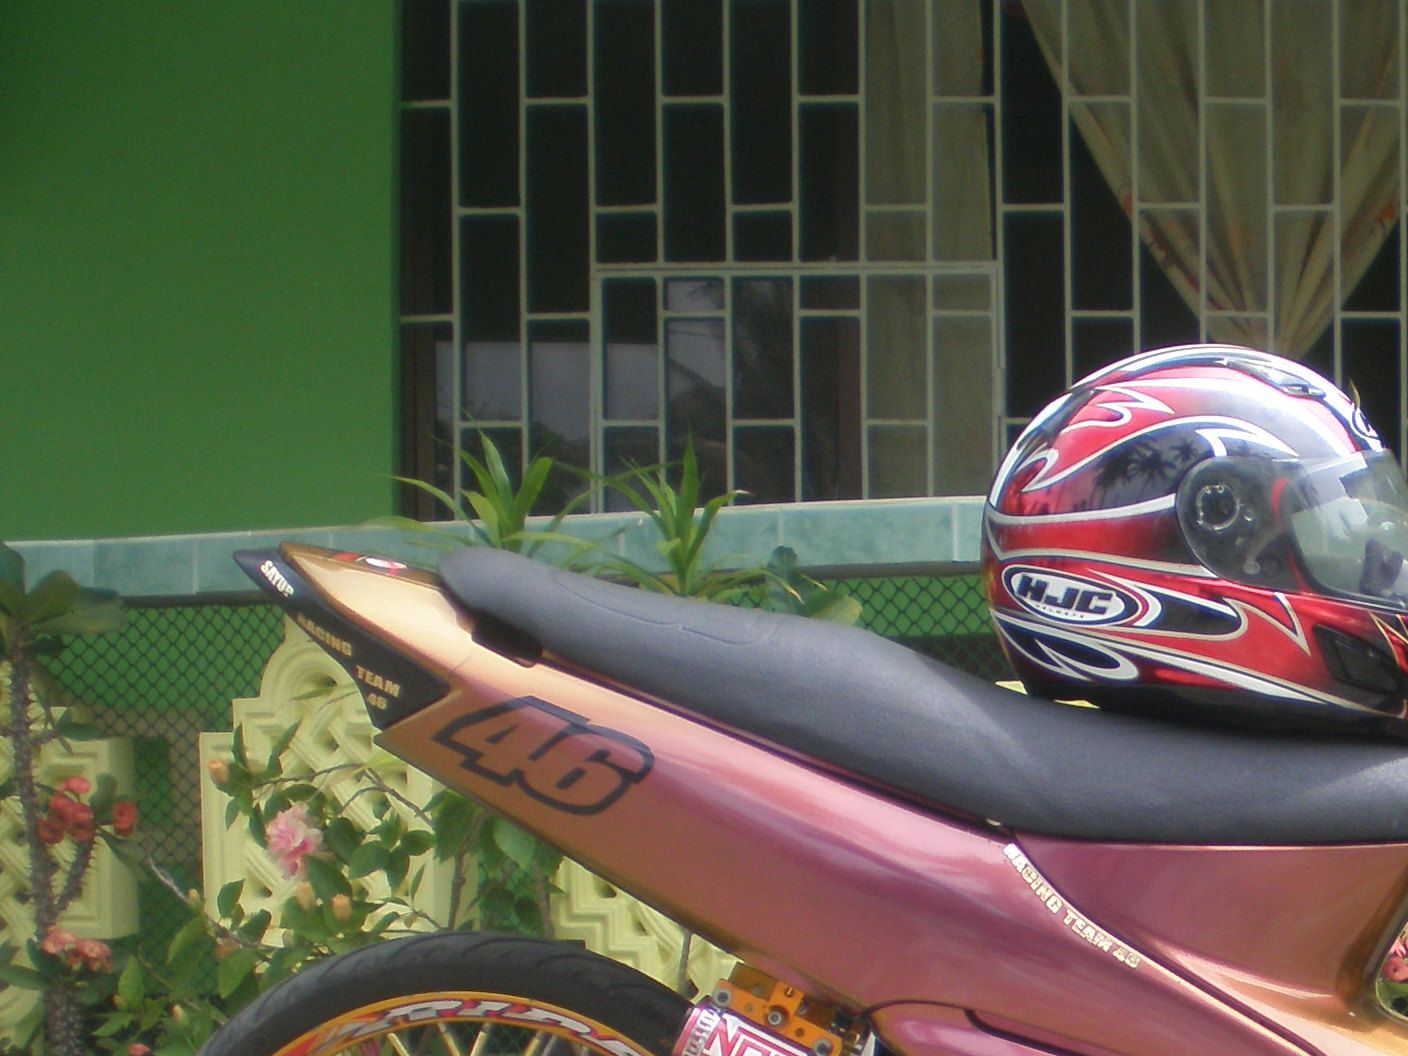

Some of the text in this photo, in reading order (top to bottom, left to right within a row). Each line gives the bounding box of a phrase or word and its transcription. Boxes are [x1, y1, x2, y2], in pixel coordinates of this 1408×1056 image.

[1017, 574, 1112, 615] HJC
[297, 613, 353, 657] RACING
[355, 664, 401, 698] TEAM
[432, 696, 655, 816] 46
[1063, 909, 1113, 952] TEAM
